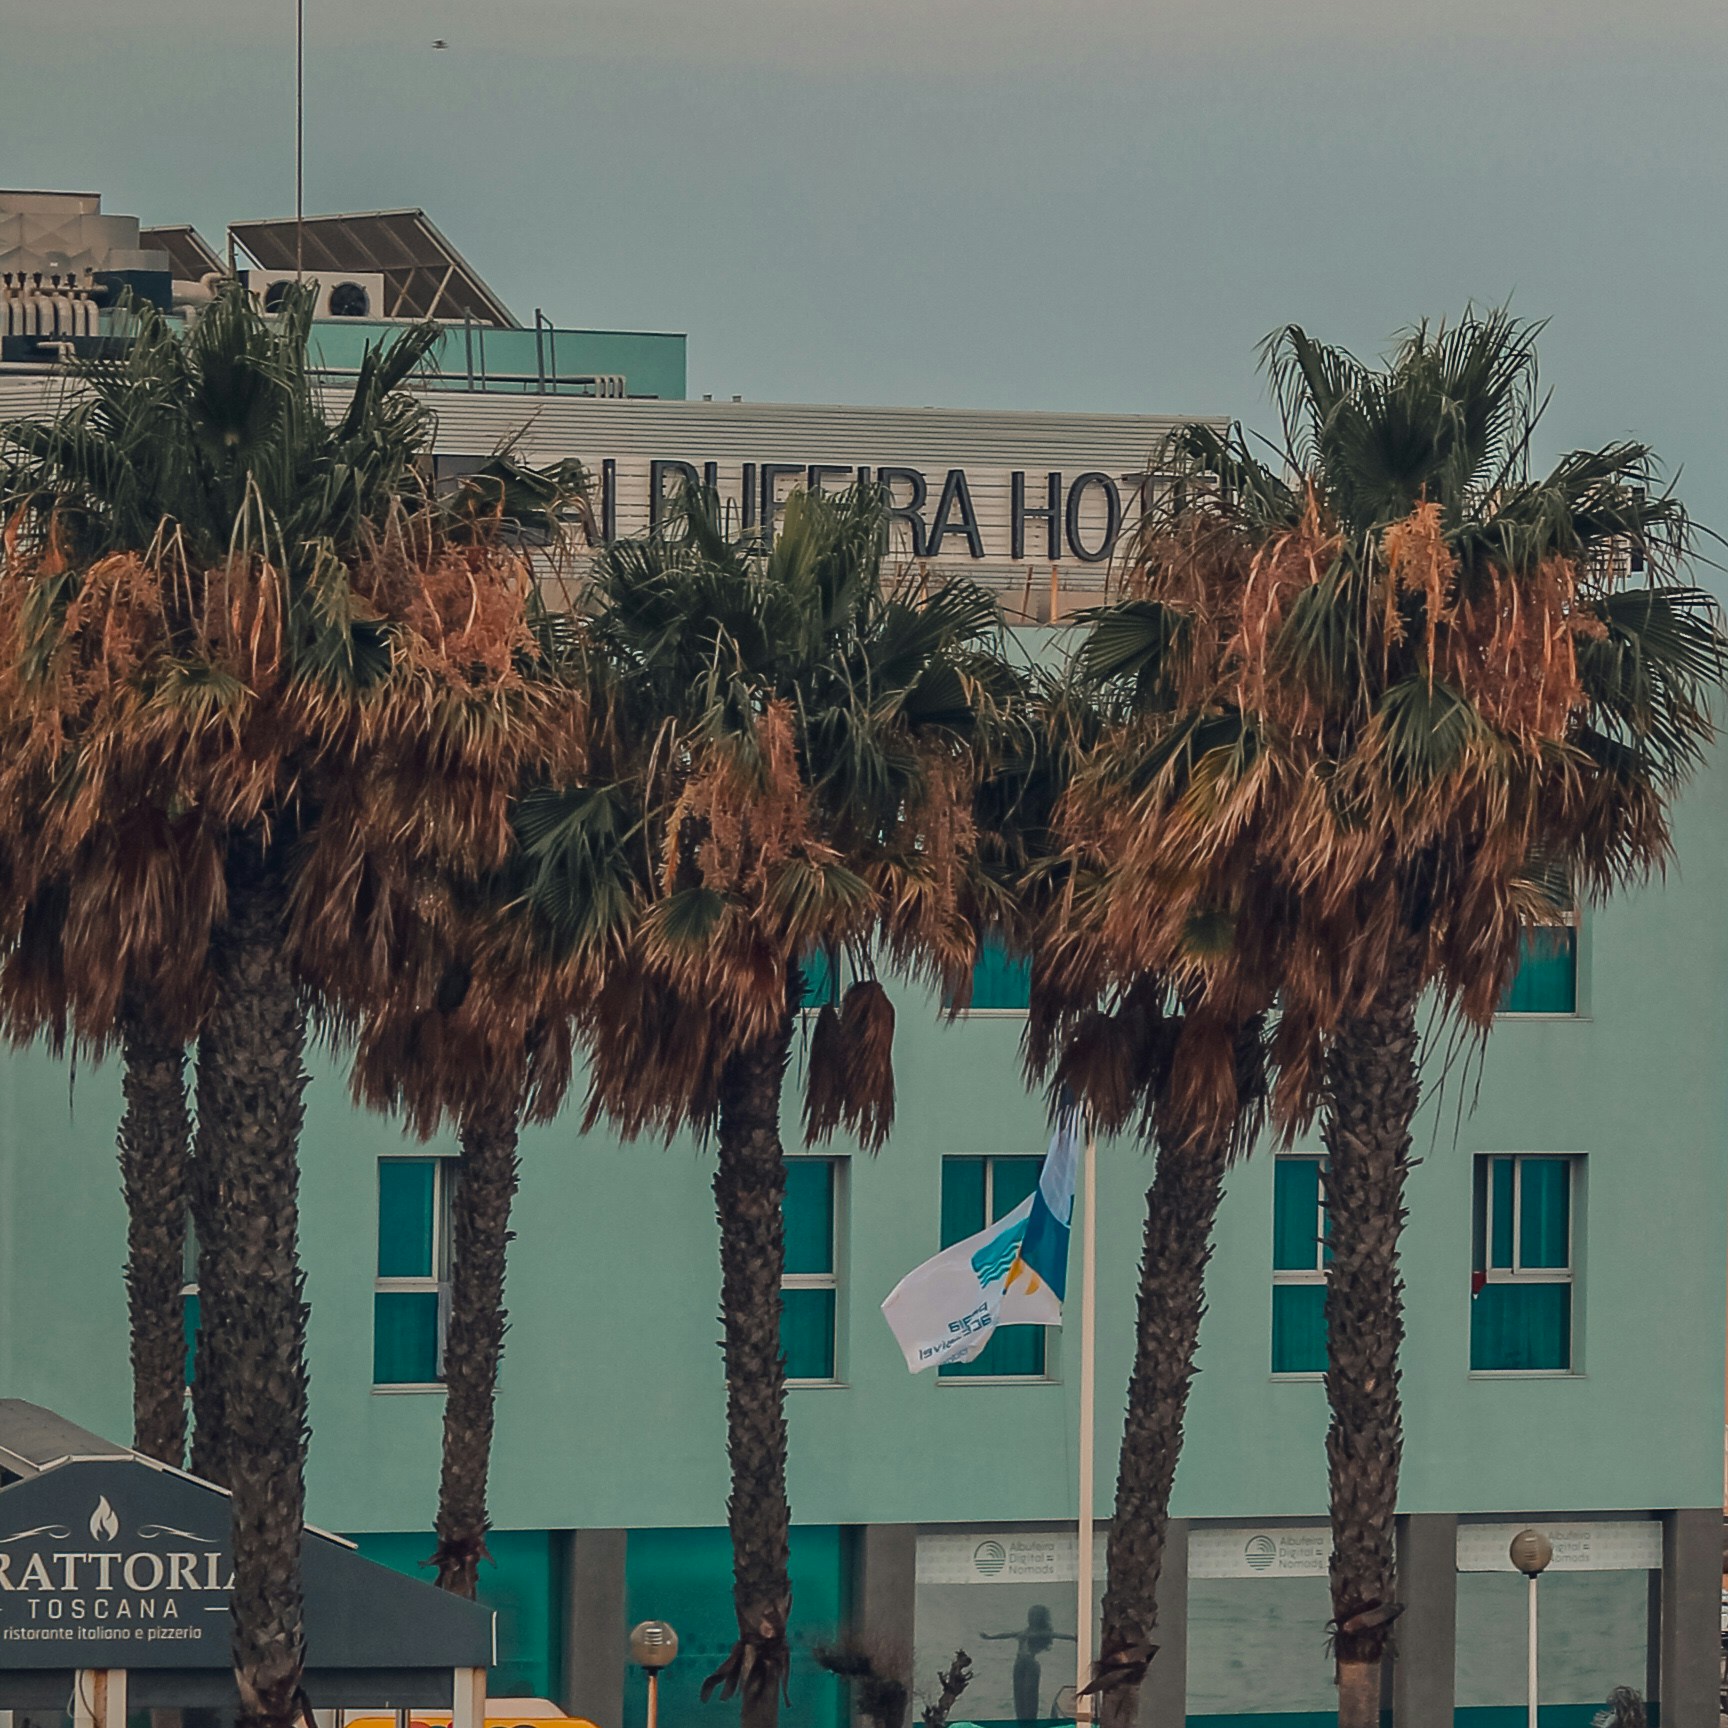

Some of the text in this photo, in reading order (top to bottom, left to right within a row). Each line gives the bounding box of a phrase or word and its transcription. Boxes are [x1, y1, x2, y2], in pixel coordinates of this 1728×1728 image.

[553, 458, 1234, 563] LBUFRA HOT
[0, 1552, 235, 1591] ATTORI
[27, 1599, 179, 1619] TOSCANA
[4, 1625, 202, 1642] ristorante italiano e pizzeria
